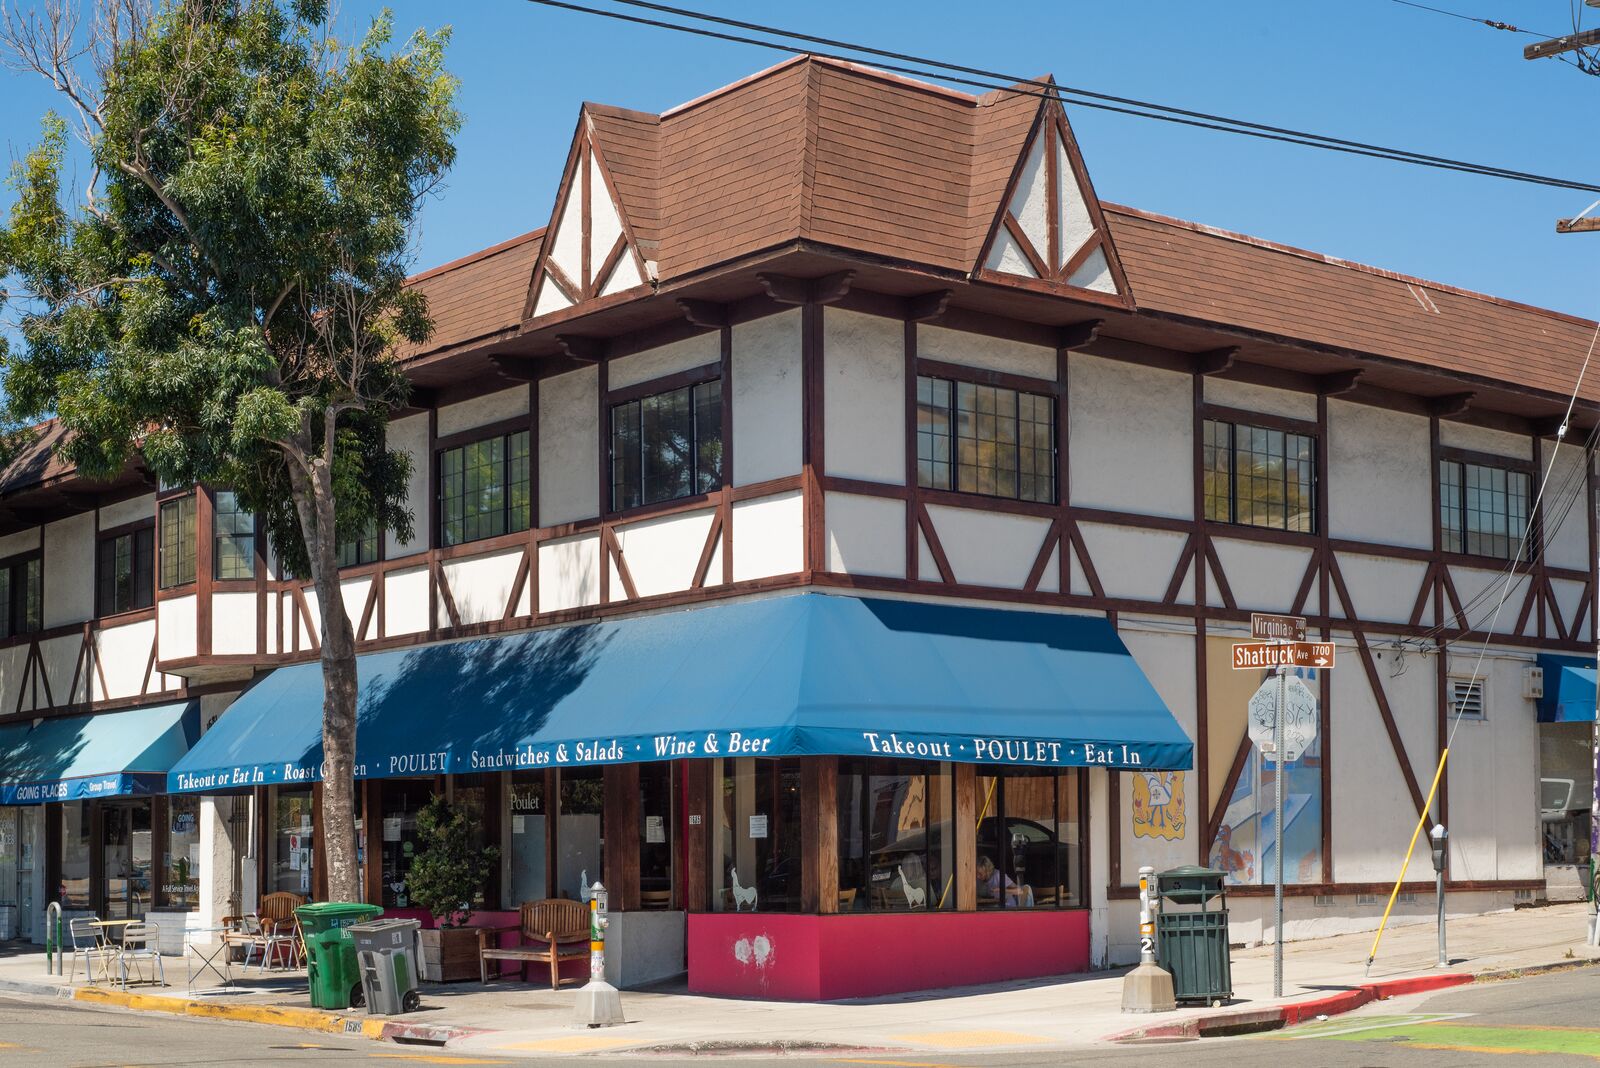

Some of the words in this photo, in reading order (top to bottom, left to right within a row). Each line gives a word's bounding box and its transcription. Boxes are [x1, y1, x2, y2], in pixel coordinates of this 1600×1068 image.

[1254, 617, 1287, 638] Virginia
[1236, 646, 1294, 665] Shattuck
[1296, 649, 1308, 660] Ave
[1312, 645, 1330, 655] 1700
[863, 732, 951, 757] Takeout
[974, 739, 1061, 762] POULET
[1084, 743, 1114, 764] Eat
[1122, 745, 1141, 765] In
[177, 773, 215, 790] Takeout
[218, 774, 230, 785] or
[232, 767, 249, 784] Eat
[252, 766, 264, 782] In
[284, 764, 315, 781] Roast
[389, 752, 447, 773] POULET
[471, 744, 550, 769] Sandwiches
[556, 743, 570, 763] &
[575, 740, 624, 761] Salads
[654, 735, 696, 757] Wine
[703, 733, 720, 754] &
[728, 732, 771, 753] Beer
[17, 785, 40, 800] GOING
[41, 783, 68, 798] PLACES
[89, 782, 103, 792] Group
[103, 780, 117, 790] Travel
[510, 792, 540, 810] Poulet
